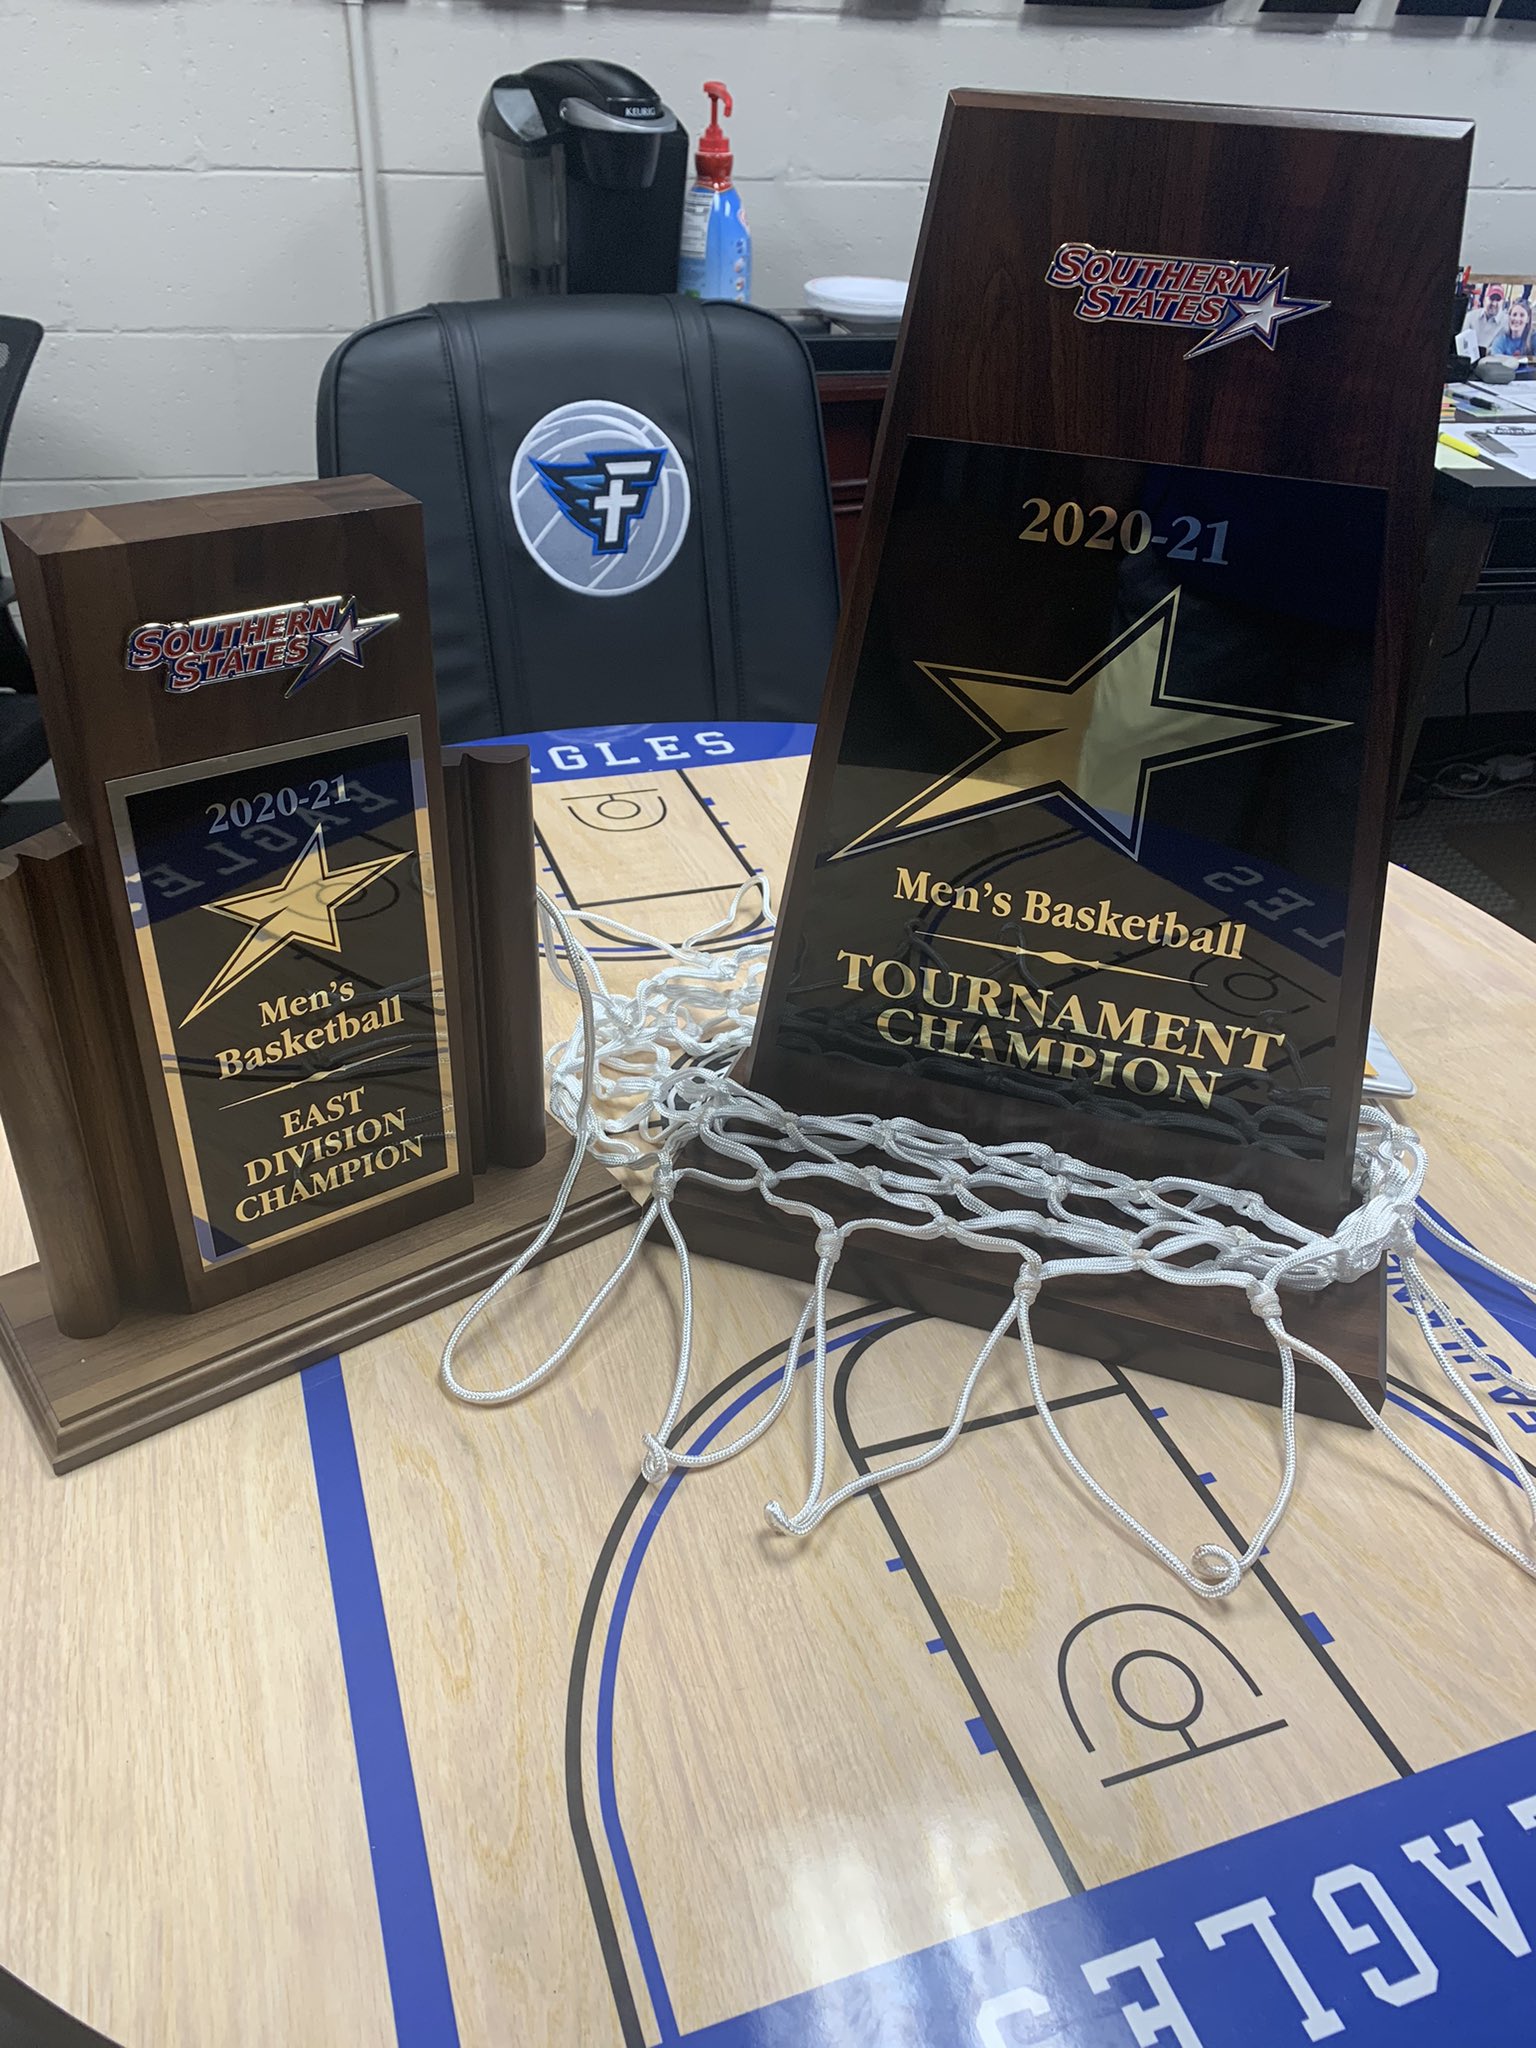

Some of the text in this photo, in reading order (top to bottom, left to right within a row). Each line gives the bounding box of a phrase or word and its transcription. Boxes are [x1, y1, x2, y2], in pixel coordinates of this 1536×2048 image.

[1050, 247, 1268, 298] SOUTHERN
[1079, 284, 1228, 326] STATES
[1019, 498, 1229, 565] 2020-21
[131, 602, 337, 666] SOUTHERN
[171, 636, 309, 690] STATES
[531, 731, 735, 774] GLES
[206, 775, 351, 834] 2020-21
[893, 866, 1246, 960] Men's Basketball
[258, 980, 355, 1027] Men's
[837, 950, 1286, 1071] TOURNAMENT
[215, 995, 405, 1080] Basketball
[876, 1007, 1223, 1110] CHAMPION
[280, 1086, 365, 1137] EAST
[235, 1135, 424, 1223] CHAMPION
[243, 1107, 408, 1187] DIVISION
